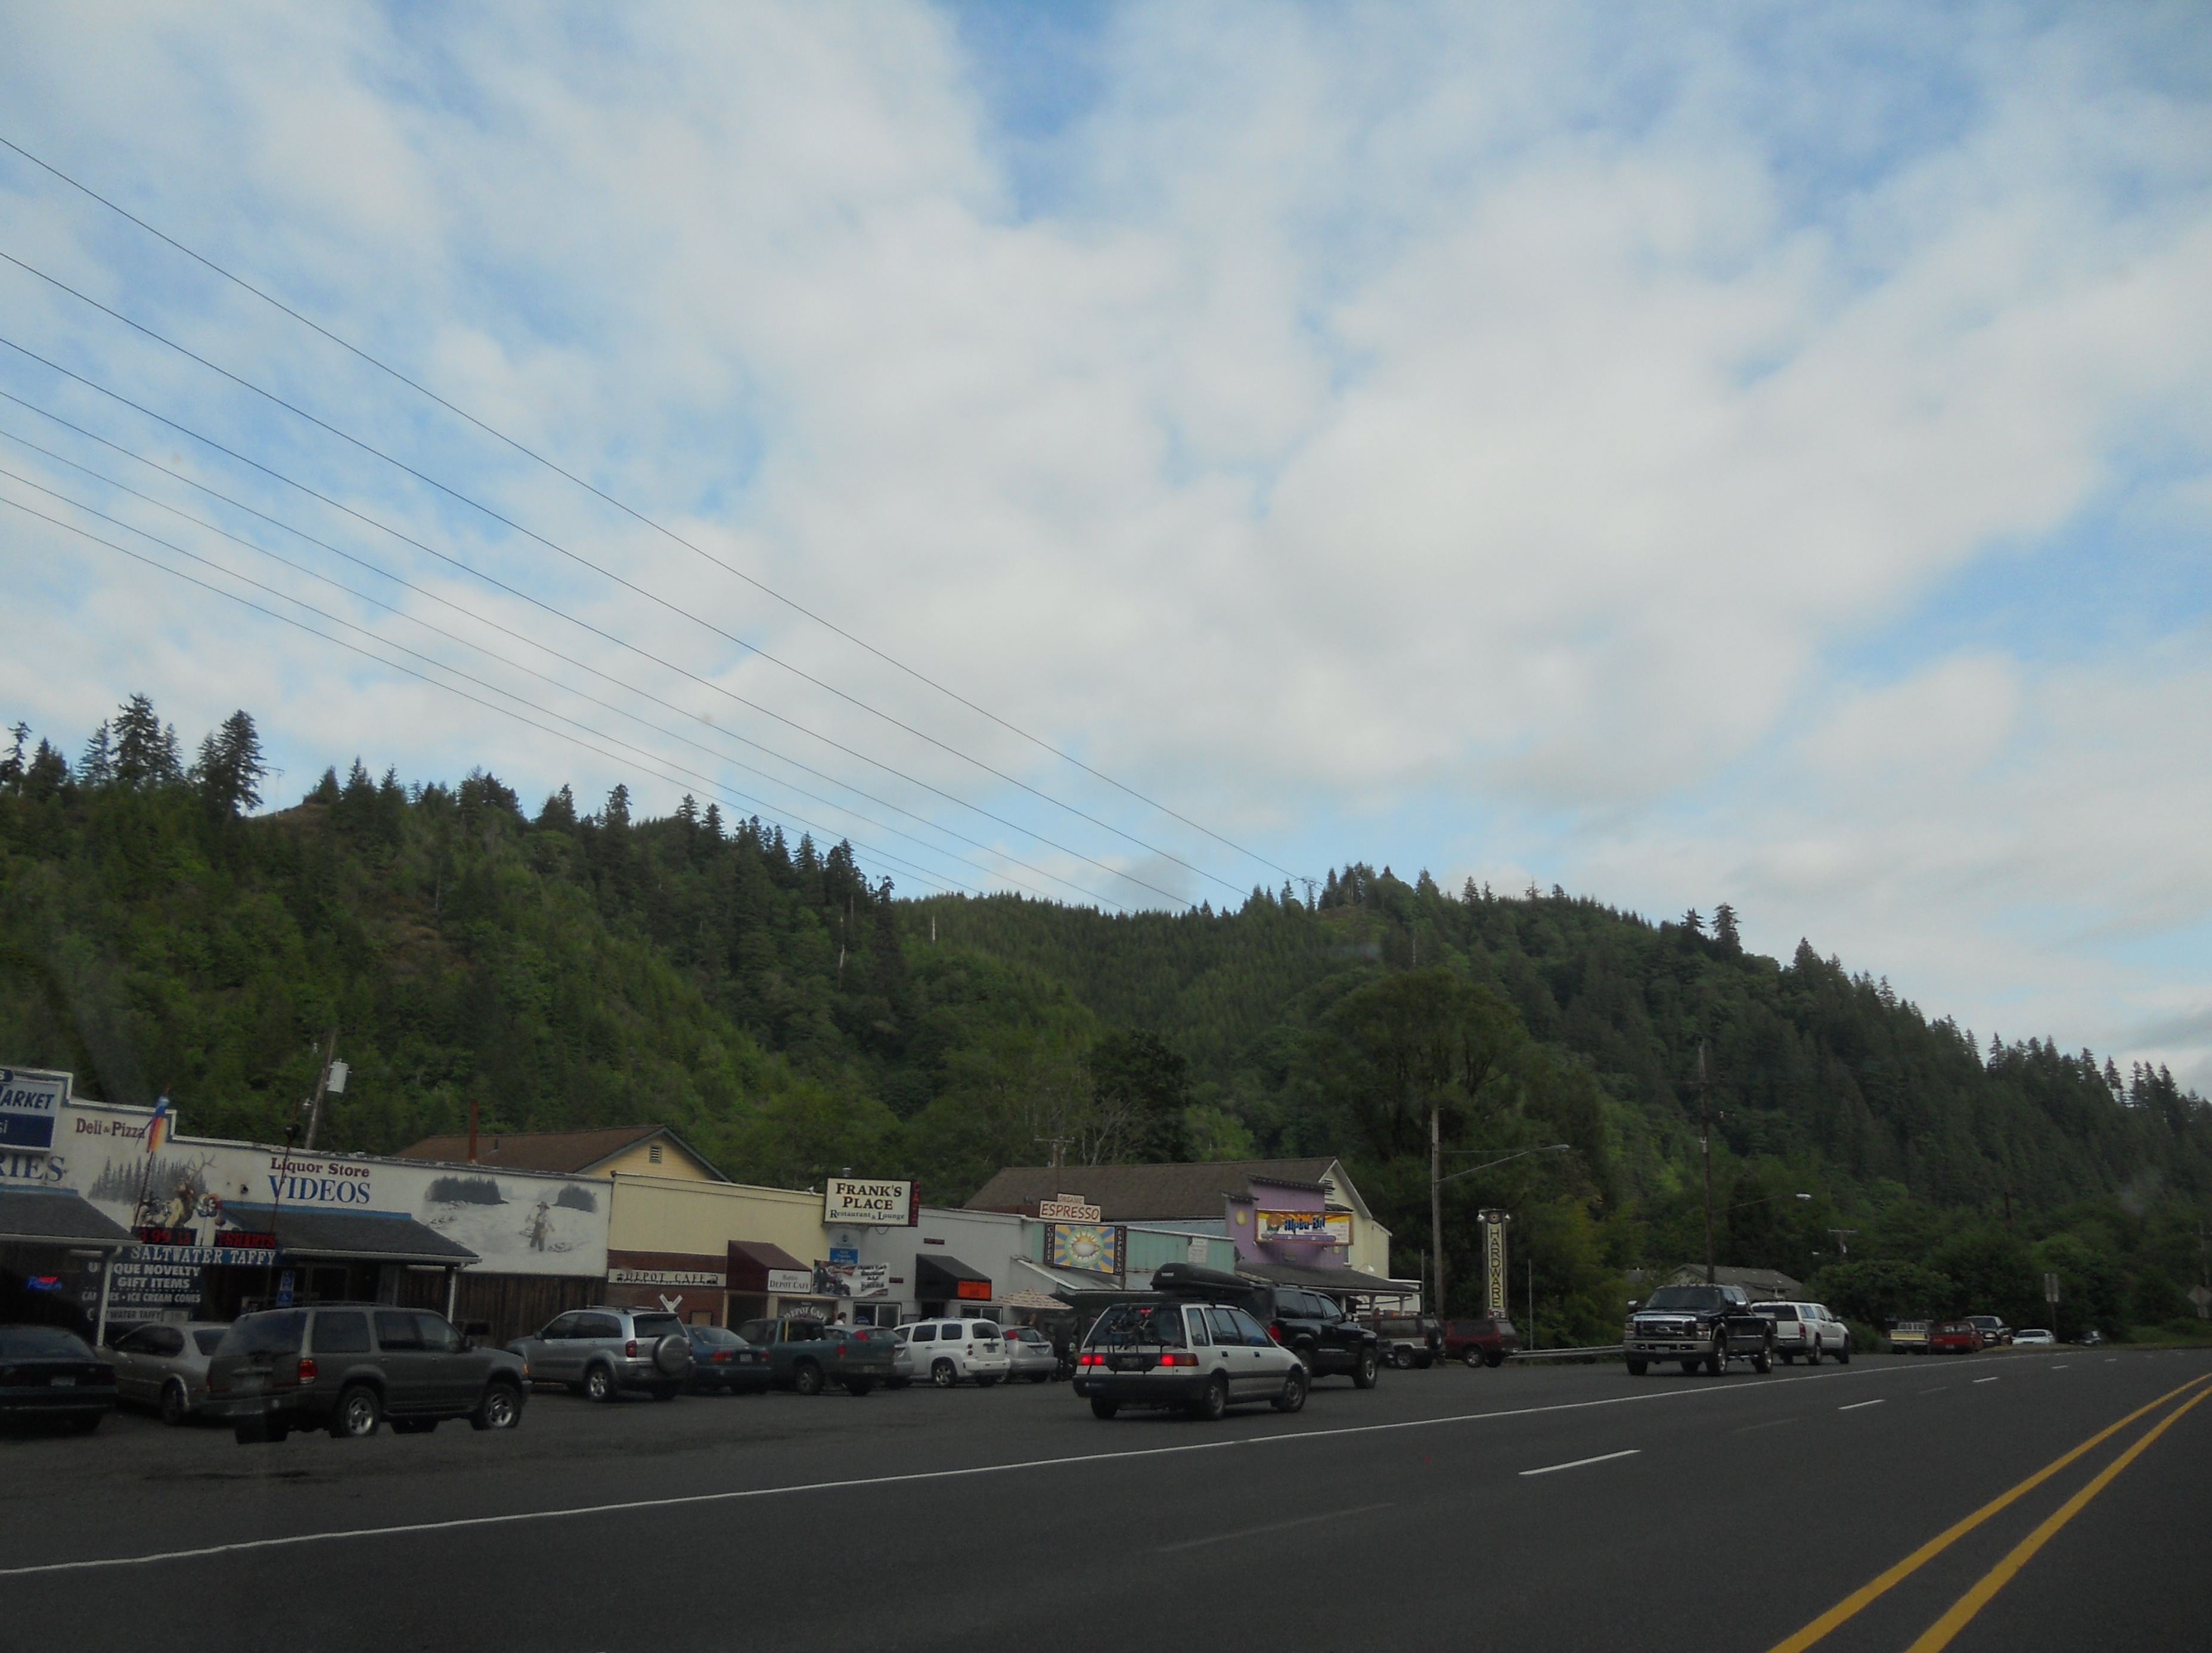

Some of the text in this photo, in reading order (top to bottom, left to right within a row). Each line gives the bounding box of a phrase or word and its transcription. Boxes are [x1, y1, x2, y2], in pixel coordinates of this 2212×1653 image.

[0, 1086, 54, 1110] ARKET
[76, 1118, 101, 1135] Deli
[111, 1121, 145, 1139] Pizza
[271, 1157, 370, 1177] Liquor Store
[268, 1174, 370, 1204] VIDEOS
[836, 1183, 902, 1197] FRANK'S
[842, 1197, 893, 1210] PLACE
[830, 1210, 871, 1218] Restaurant
[878, 1211, 905, 1220] Lounge
[1041, 1204, 1099, 1220] ESPRESSO
[131, 1246, 276, 1264] SALTWATER TAFFY
[88, 1262, 201, 1276] UQUE NOVELTY
[1490, 1229, 1501, 1307] HARDWARE
[117, 1277, 190, 1289] GIFT ITEMS
[624, 1272, 666, 1284] DEPOT
[127, 1293, 141, 1301] ICE
[142, 1293, 172, 1302] CREAM
[174, 1294, 201, 1303] CONES
